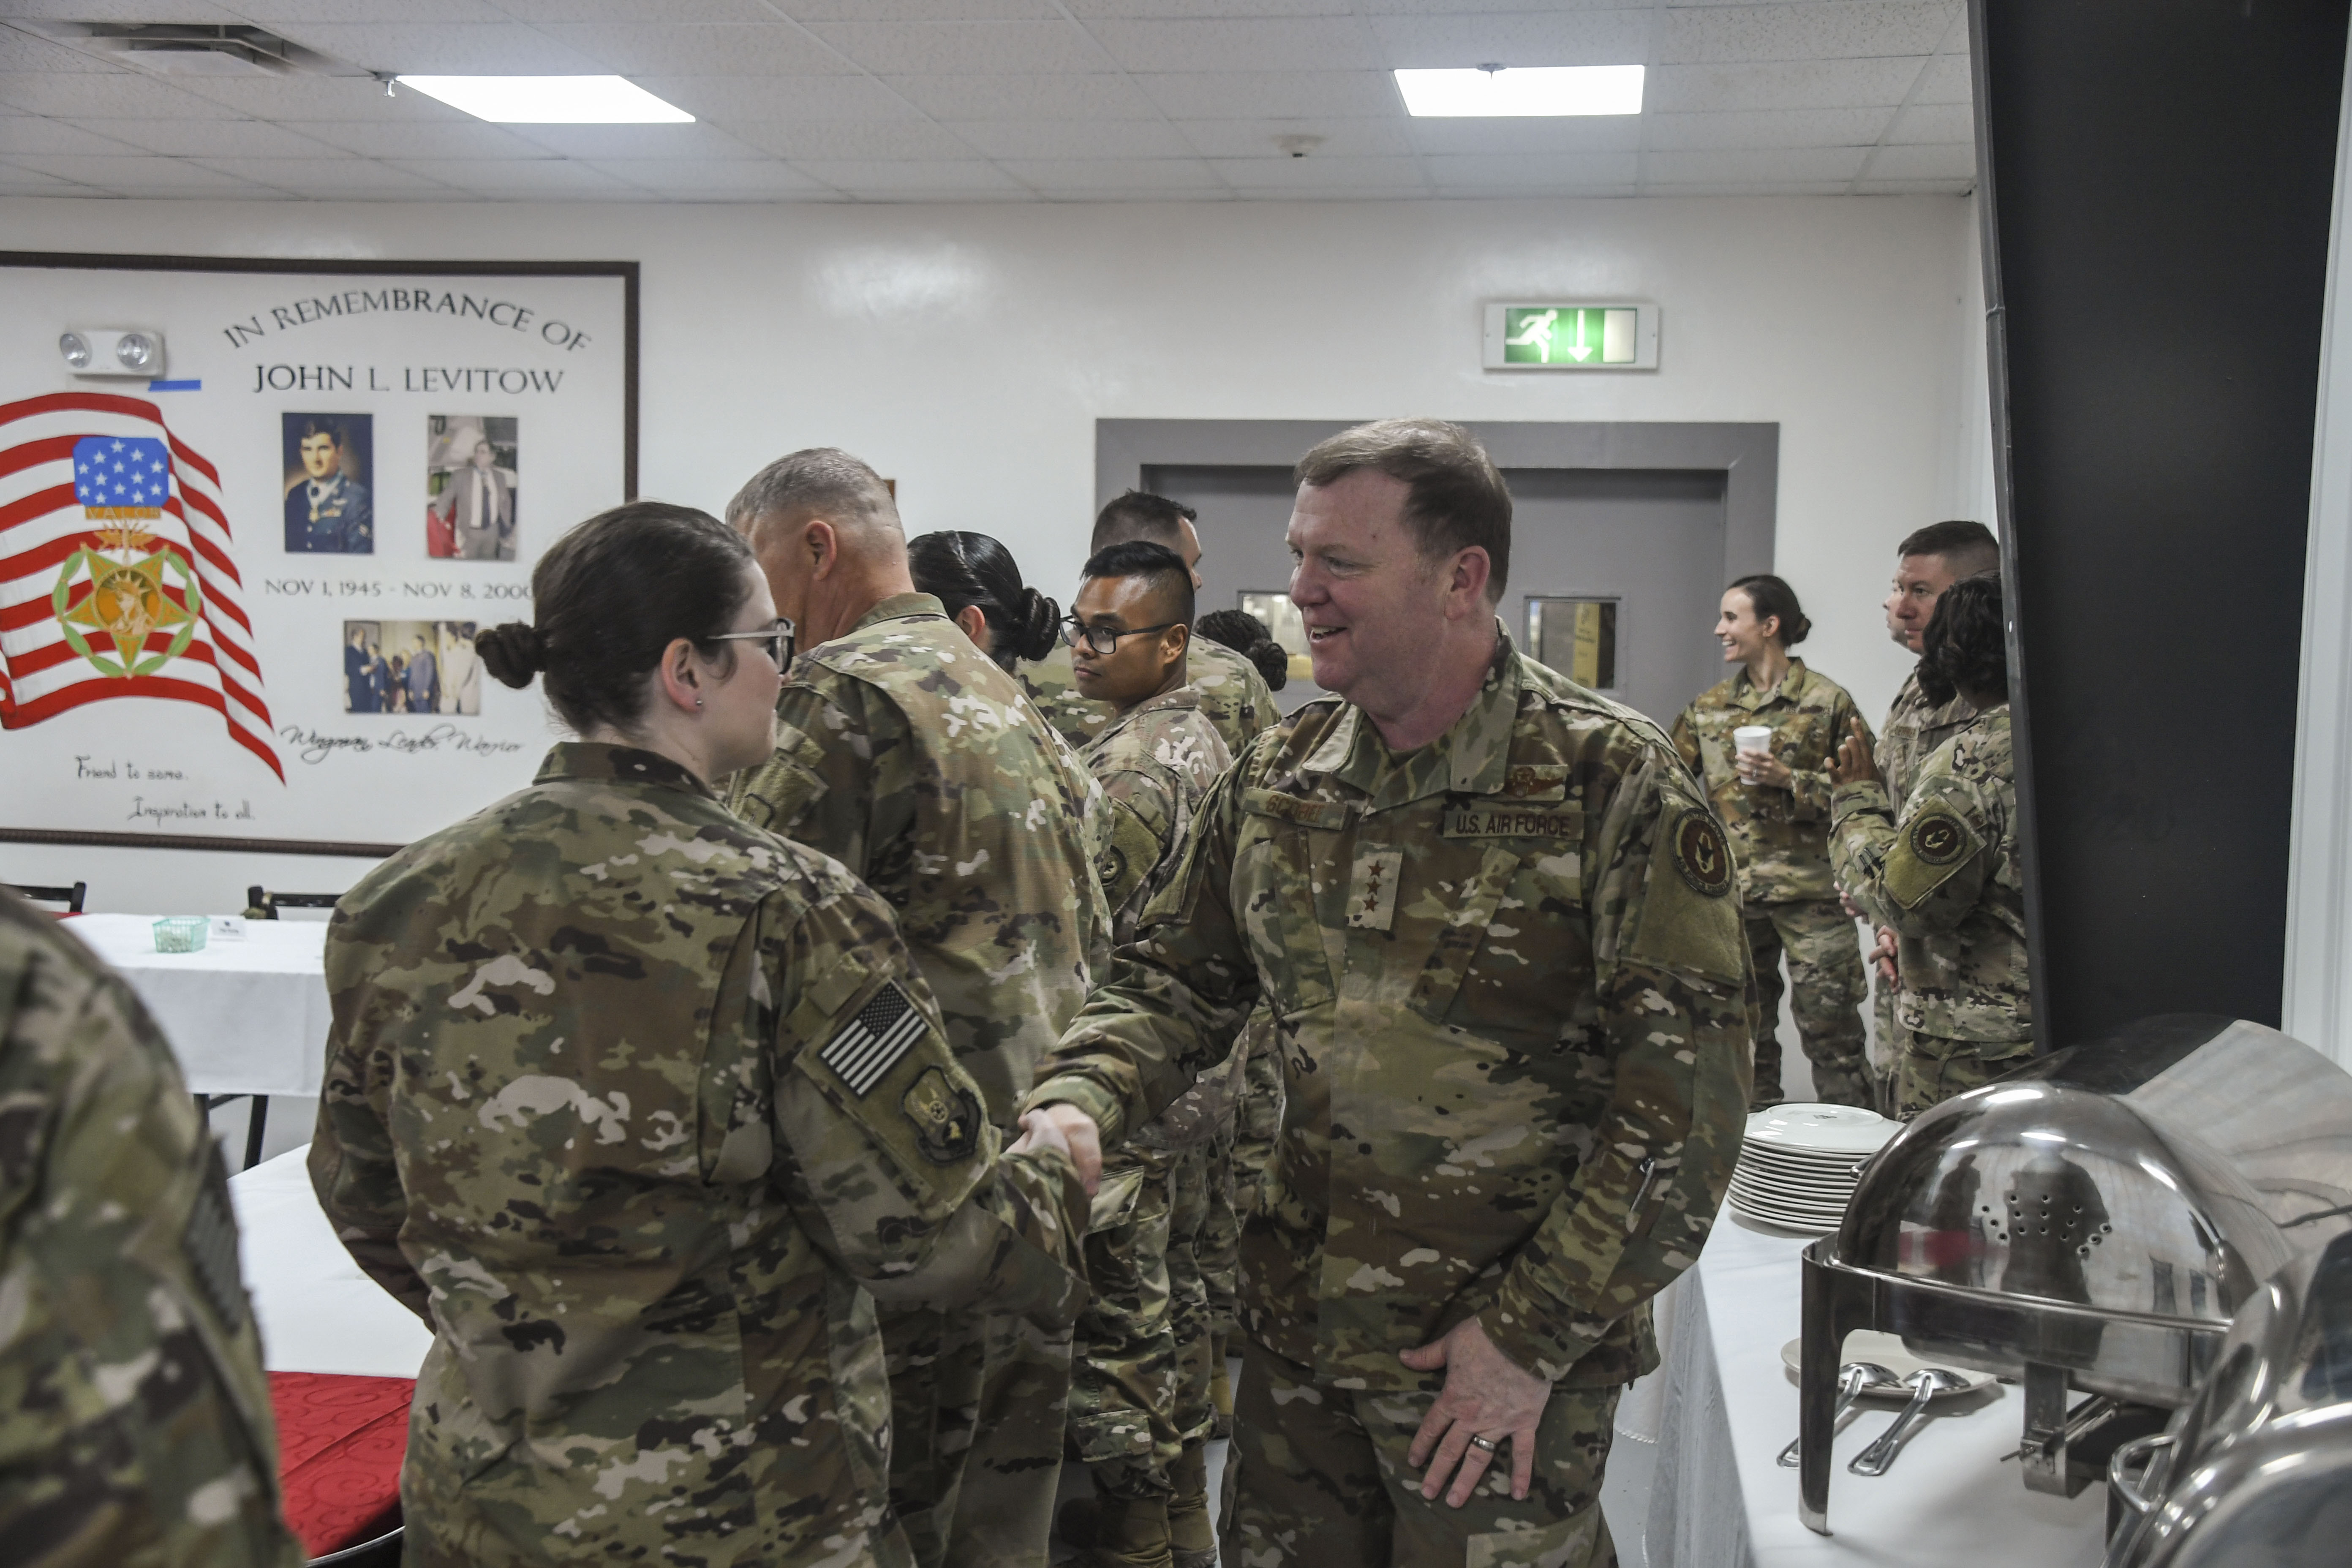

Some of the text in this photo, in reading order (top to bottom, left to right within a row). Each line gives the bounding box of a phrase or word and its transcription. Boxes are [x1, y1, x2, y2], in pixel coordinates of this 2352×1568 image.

[224, 288, 592, 351] IN REMEMBRANCE OF
[253, 364, 353, 393] JOHN
[405, 367, 564, 395] LEVITOW
[265, 579, 314, 596] NOV
[340, 580, 381, 597] 1945
[403, 581, 452, 599] NOV
[74, 754, 117, 779] Friend
[126, 760, 140, 779] to
[127, 795, 207, 828] Inspiration
[215, 800, 229, 819] to
[1456, 814, 1571, 836] U.S. AIR FORCE
